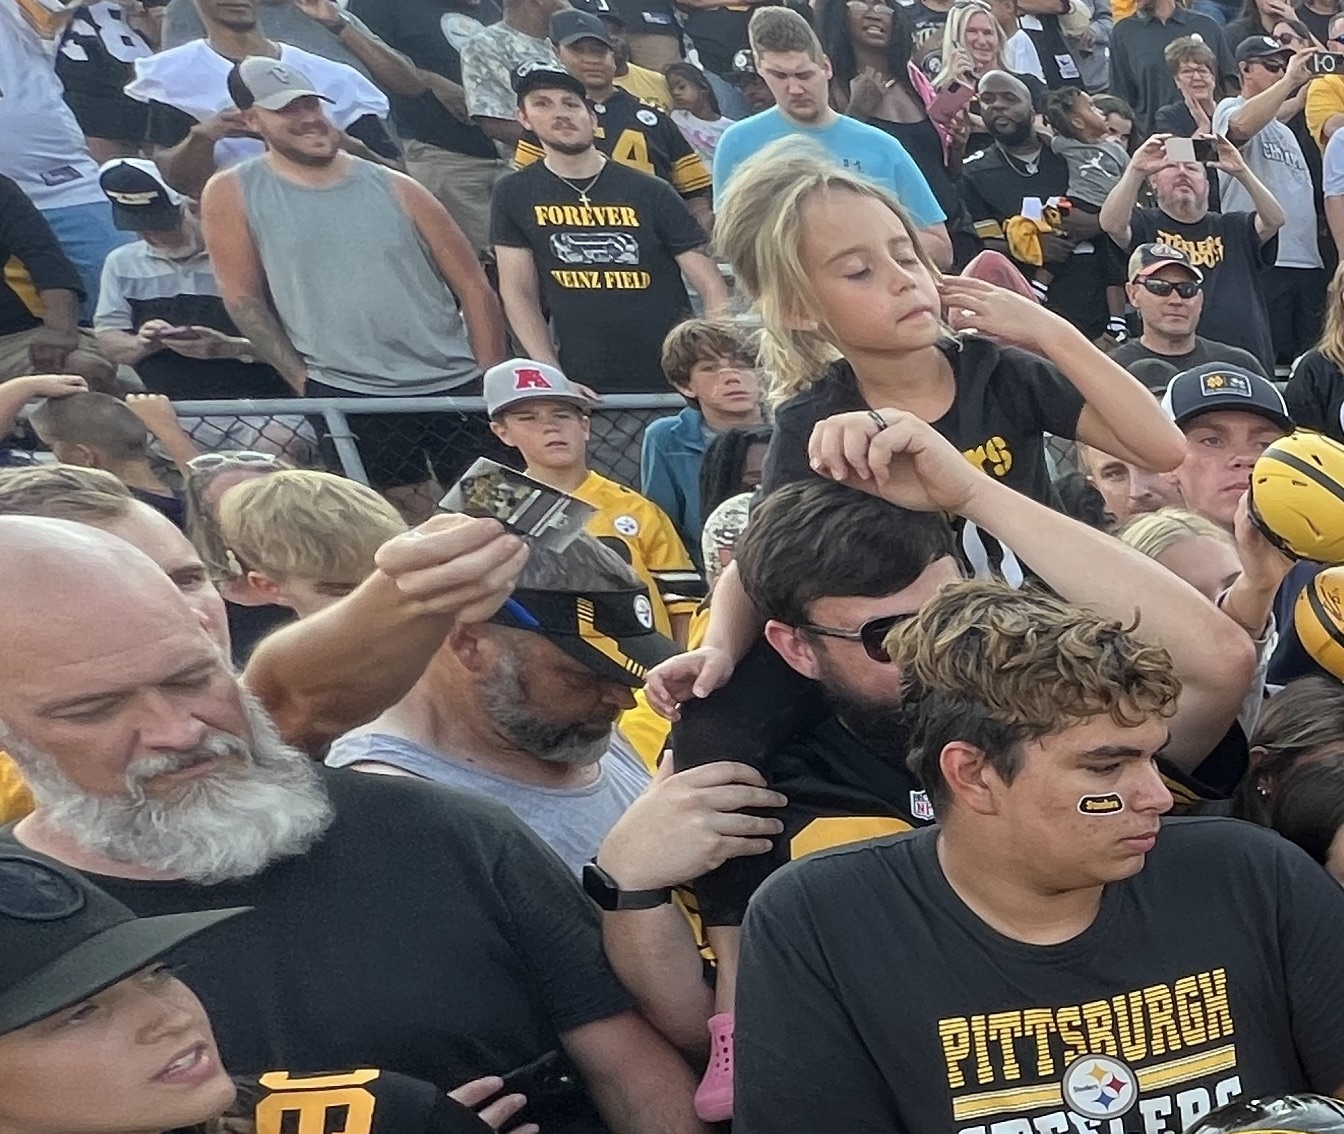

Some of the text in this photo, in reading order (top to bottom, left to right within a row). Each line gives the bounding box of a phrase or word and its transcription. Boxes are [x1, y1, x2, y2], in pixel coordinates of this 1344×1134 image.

[534, 205, 640, 228] FOREVER
[604, 272, 651, 288] FIELD
[937, 967, 1235, 1089] PITTSBURGH
